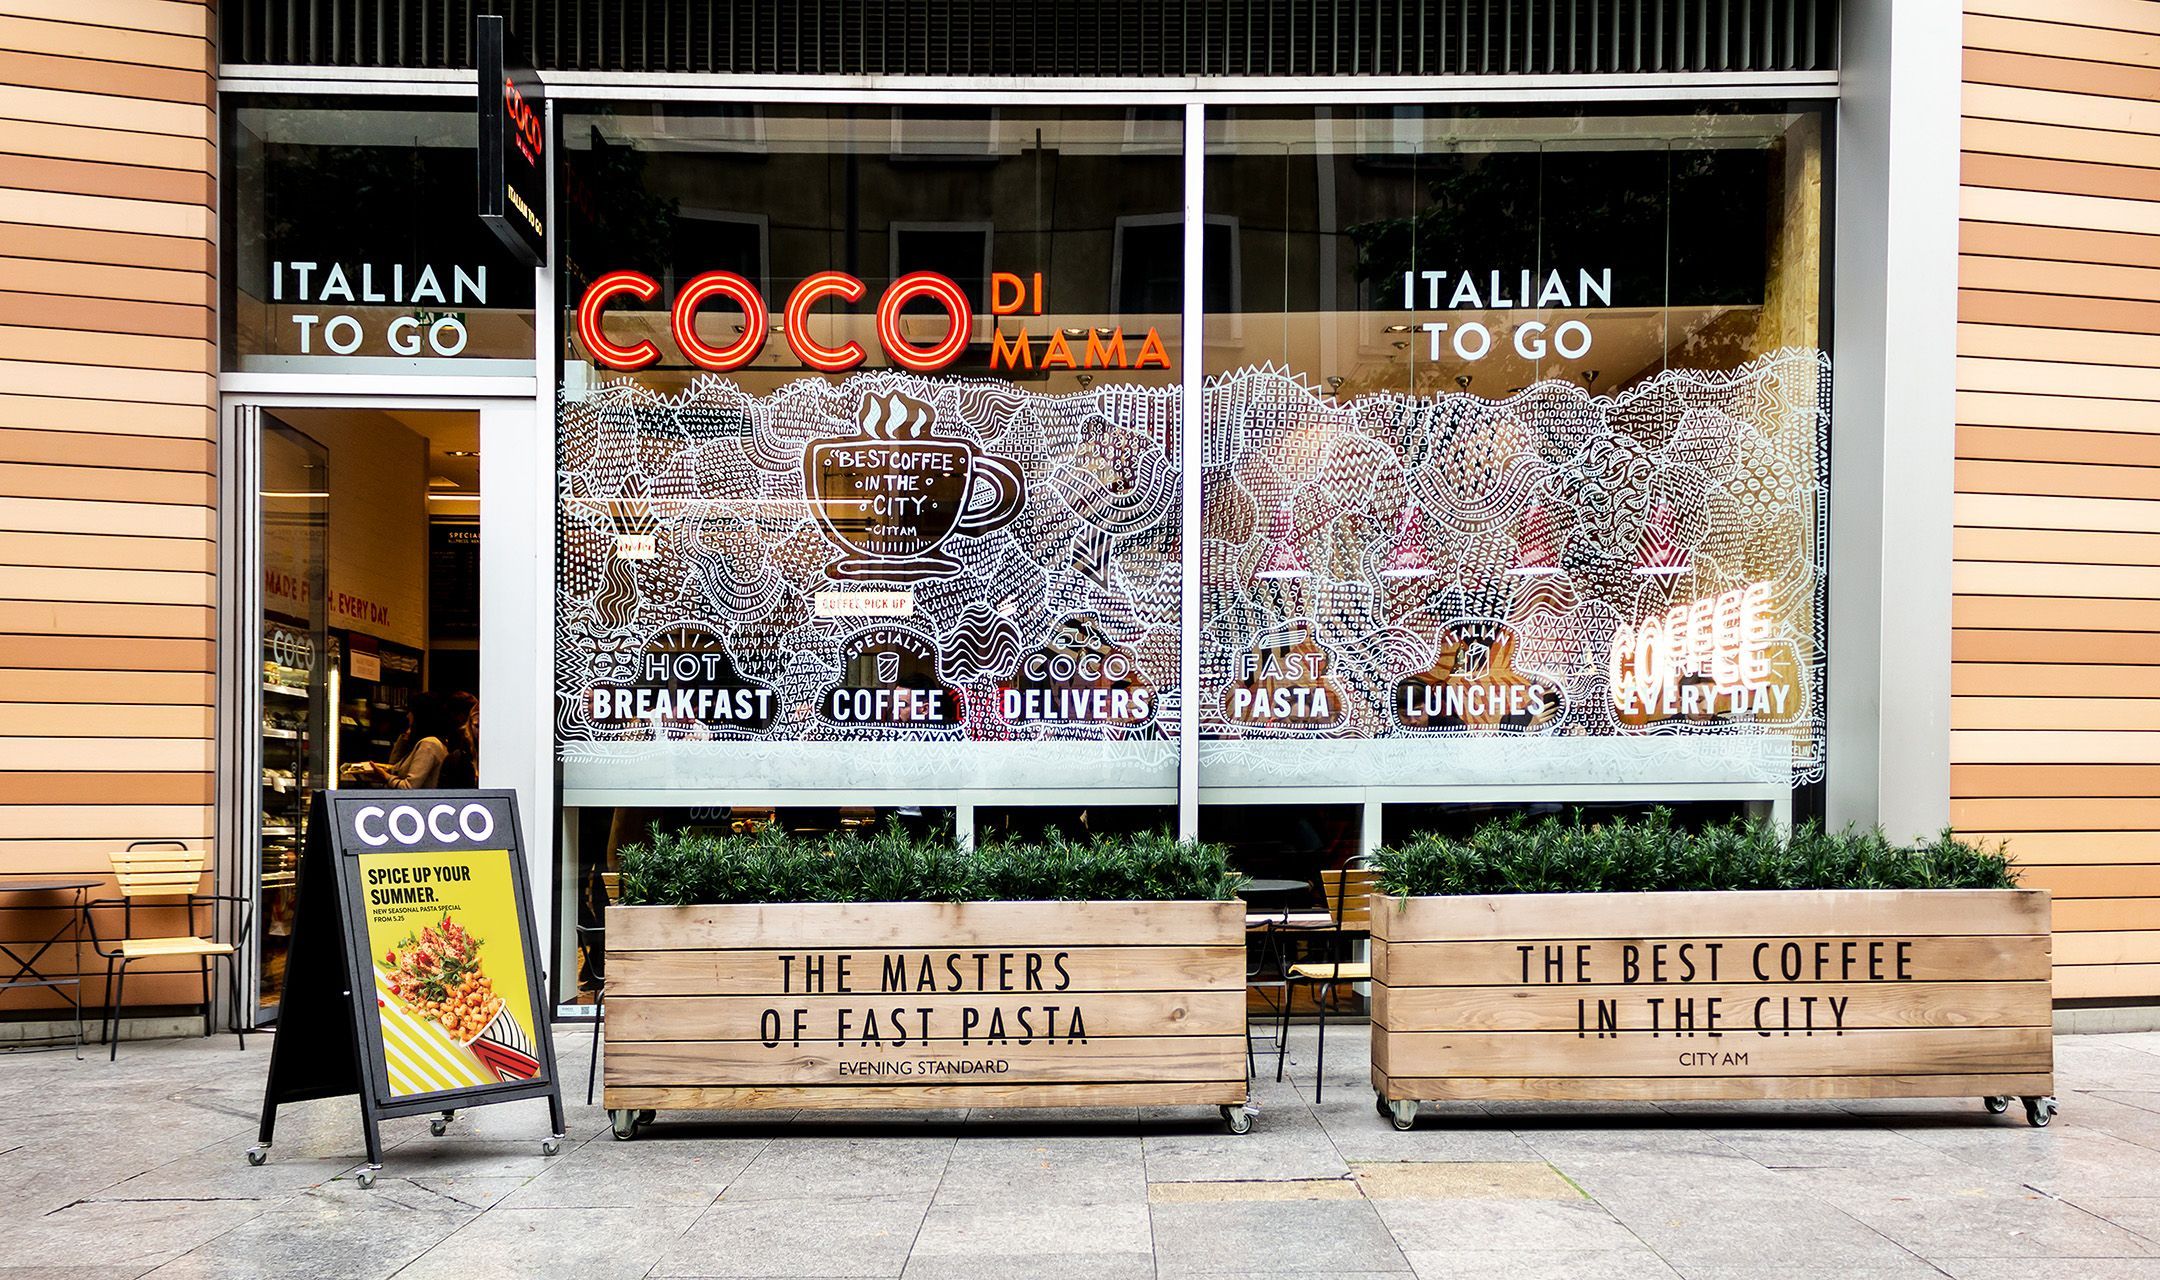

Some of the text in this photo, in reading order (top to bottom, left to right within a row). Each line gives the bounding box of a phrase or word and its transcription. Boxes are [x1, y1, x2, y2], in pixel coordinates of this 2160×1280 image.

[506, 77, 542, 155] COCO
[507, 183, 542, 237] ITALIAN TO GO
[273, 261, 487, 304] ITALIAN
[991, 272, 1043, 315] DI
[1403, 267, 1612, 310] ITALIAN
[292, 314, 468, 357] TO GO
[577, 270, 973, 371] COCO
[989, 326, 1172, 370] MAMA
[1421, 319, 1593, 361] TO GO
[889, 452, 954, 471] COFFEE
[864, 474, 920, 492] IN THE
[873, 494, 928, 517] CITY
[449, 531, 480, 539] SPECIA
[265, 568, 297, 601] MADE
[338, 592, 369, 621] EVERY
[370, 602, 391, 627] DAY.
[864, 598, 889, 609] PICK
[892, 598, 906, 609] UP
[273, 630, 316, 672] COCO
[846, 631, 931, 661] SPECIALTY
[1444, 624, 1511, 647] ITALIAN
[645, 653, 721, 682] HOT
[1023, 653, 1130, 682] COCO
[1241, 652, 1324, 681] FAST
[593, 687, 774, 720] BREAKFAST
[832, 688, 945, 722] COFFEE
[1003, 687, 1151, 720] DELIVERS
[1234, 687, 1329, 718] PASTA
[1406, 684, 1546, 717] LUNCHES
[1623, 684, 1790, 716] EVERY DAY
[354, 803, 495, 846] COCO
[368, 865, 471, 885] SPICE UP YOUR
[370, 887, 439, 905] SUMMER.
[388, 906, 419, 914] SEASONAL
[438, 904, 462, 912] SPECIAL
[778, 952, 1072, 994] THE MASTERS
[1516, 941, 1914, 984] THE BEST COFFEE
[760, 1006, 1089, 1049] OF FAST PASTA
[1577, 996, 1849, 1039] IN THE CITY
[839, 1059, 1010, 1076] EVENING STANDARD
[1679, 1051, 1750, 1067] CITY AM
